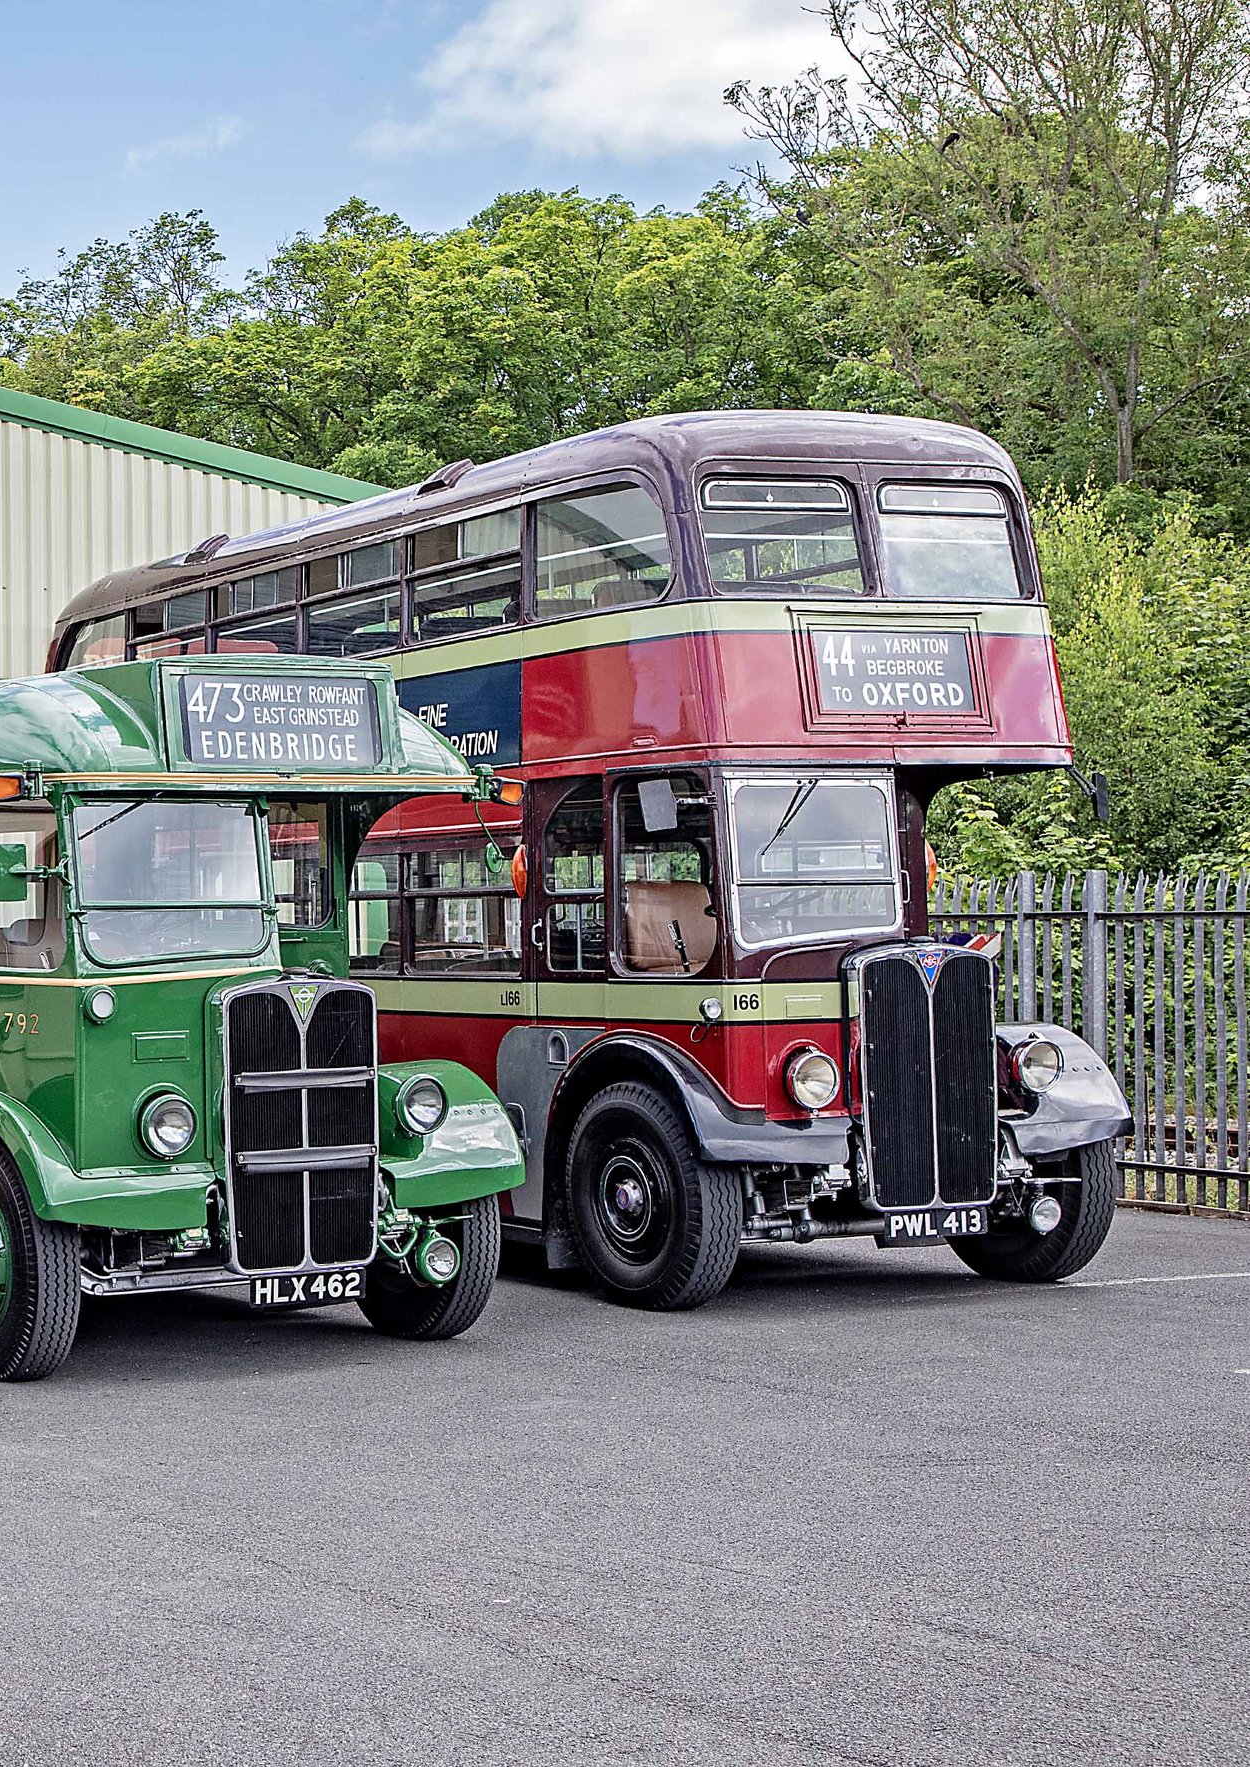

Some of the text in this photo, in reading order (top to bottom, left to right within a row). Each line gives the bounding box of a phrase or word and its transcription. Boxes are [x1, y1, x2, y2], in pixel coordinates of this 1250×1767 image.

[823, 636, 855, 676] 44
[861, 638, 948, 655] VIA YARNTON
[866, 660, 945, 676] BEGBROKE
[187, 682, 244, 723] 473
[244, 684, 365, 705] CRAWLEY ROWFANT
[832, 682, 964, 706] TO OXFORD
[253, 708, 359, 727] EAST GRINSTEAD
[419, 703, 449, 727] FINE
[202, 731, 358, 762] EDENBRIDGE
[445, 729, 498, 757] RATION
[733, 993, 759, 1011] 166
[890, 1209, 981, 1238] PWL 413
[255, 1272, 361, 1304] HLX 462
